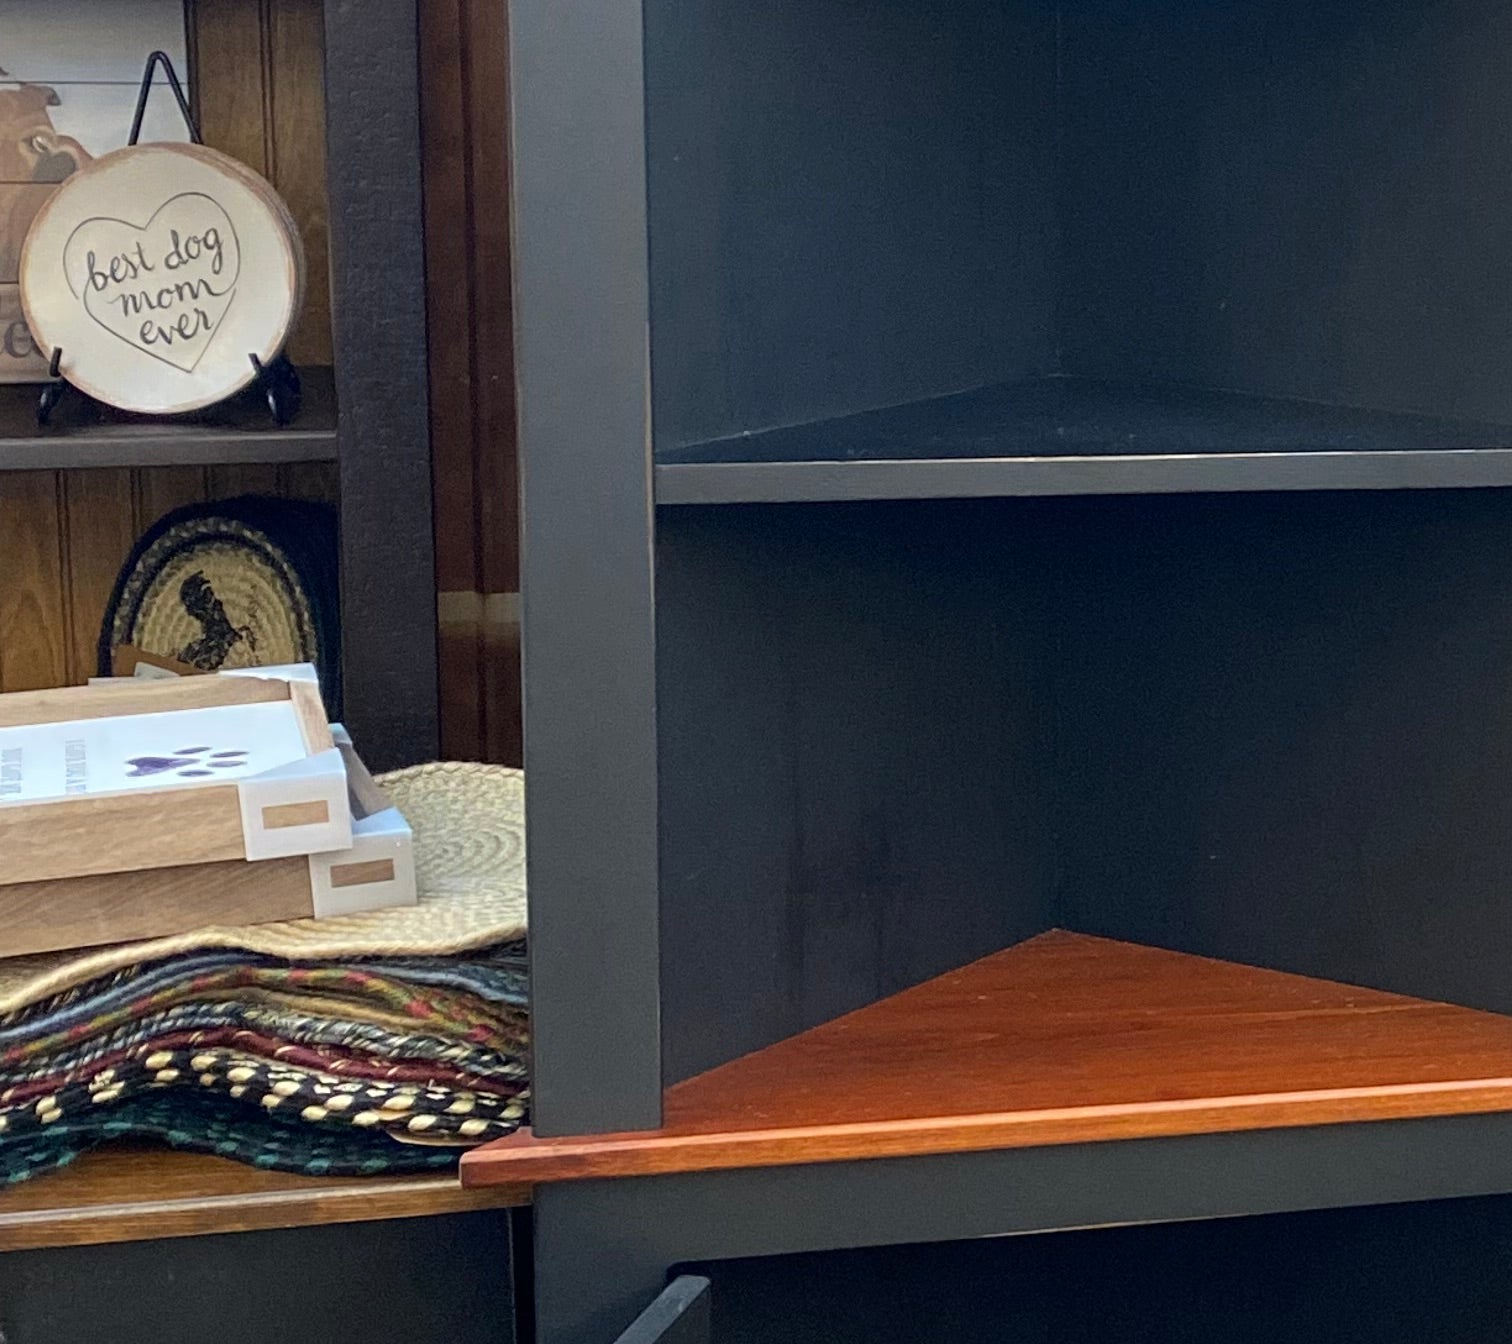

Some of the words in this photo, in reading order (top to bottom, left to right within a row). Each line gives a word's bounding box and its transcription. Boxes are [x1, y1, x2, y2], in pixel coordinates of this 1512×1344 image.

[86, 241, 155, 292] best
[163, 227, 223, 275] dog
[107, 278, 236, 318] mom
[139, 307, 214, 346] ever
